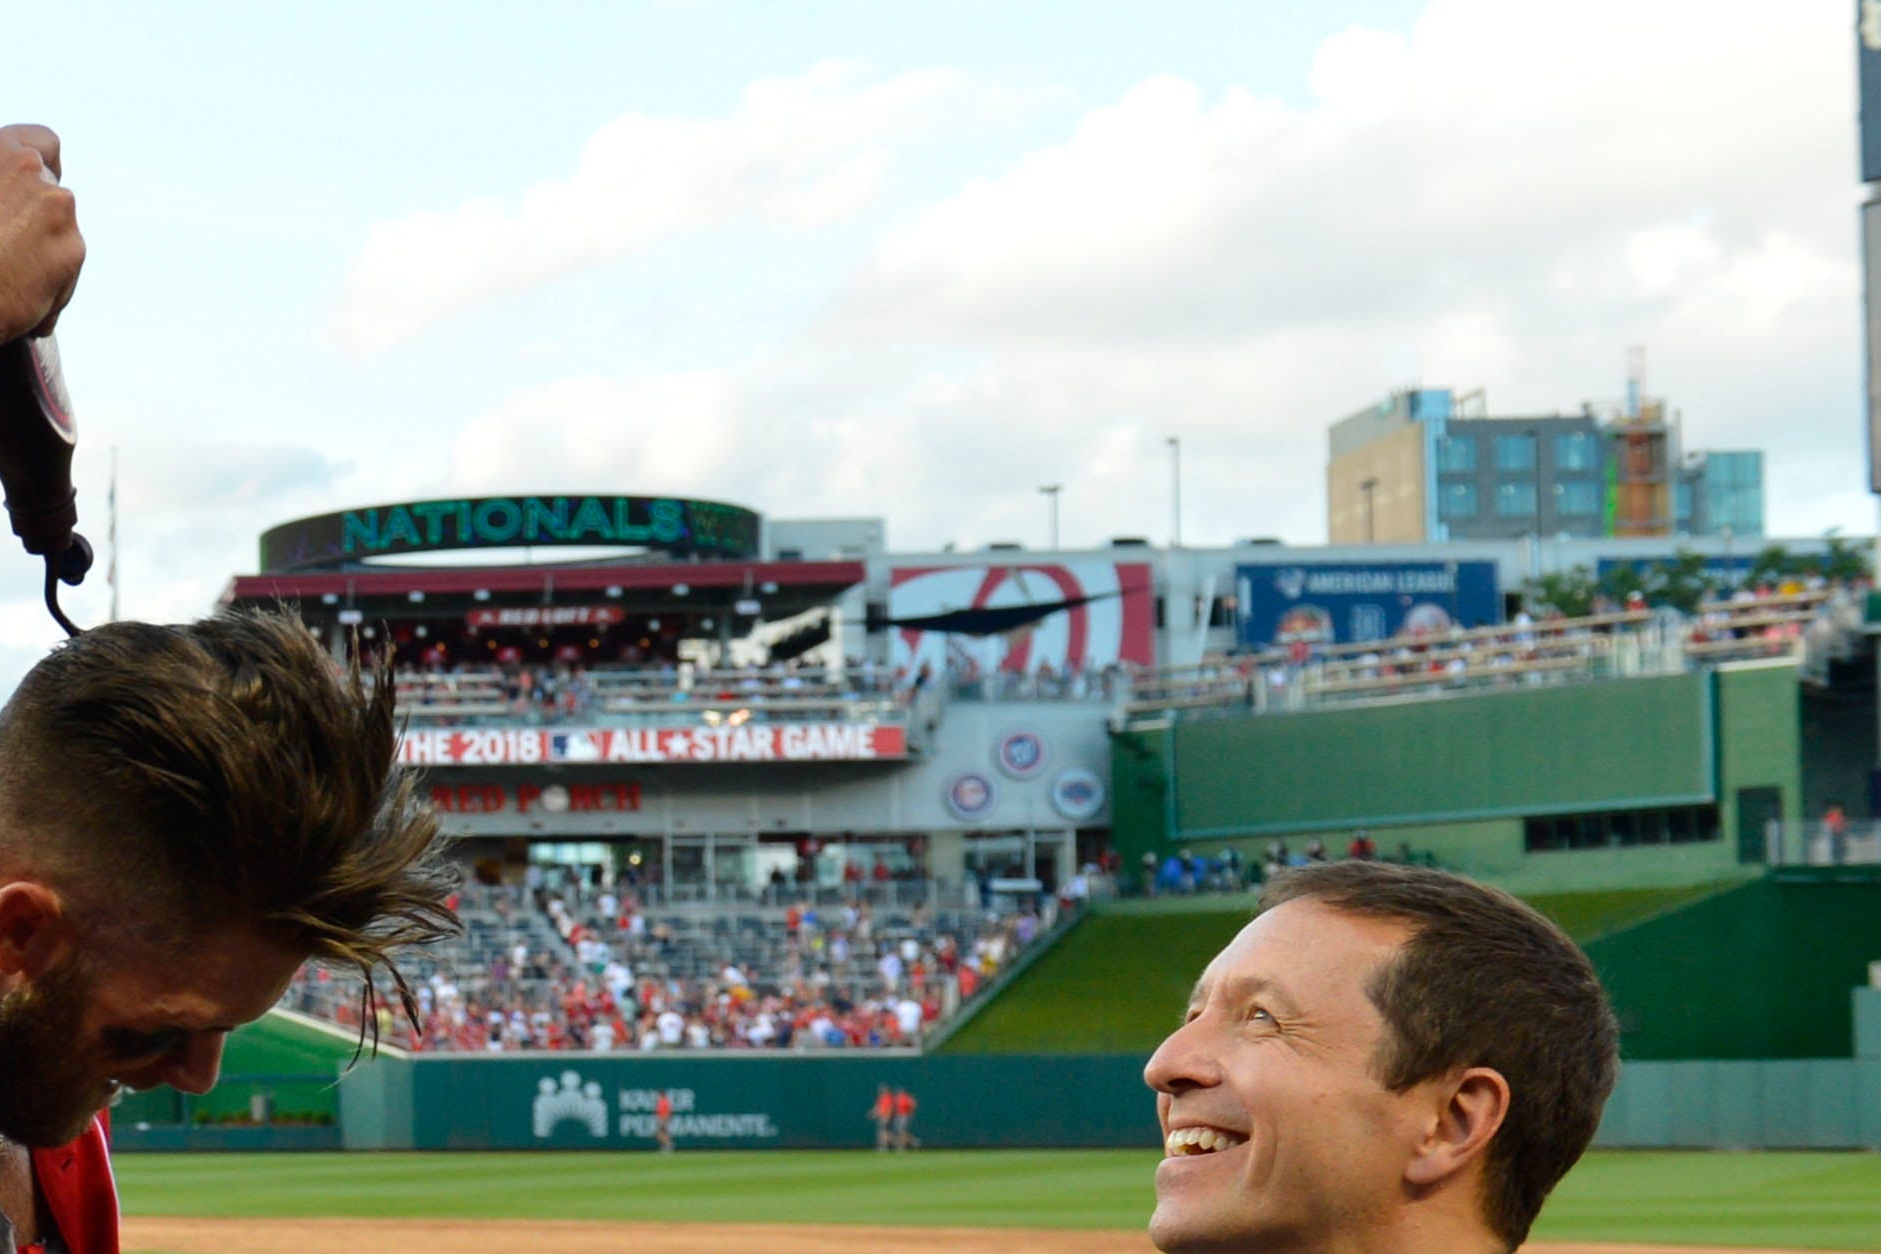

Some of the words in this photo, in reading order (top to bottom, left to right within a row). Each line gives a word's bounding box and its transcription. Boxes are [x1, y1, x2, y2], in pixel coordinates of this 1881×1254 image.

[342, 496, 684, 552] NATIONALS
[1309, 571, 1393, 594] AMERICAN
[397, 730, 451, 762] THE
[461, 730, 543, 762] 2018
[607, 728, 665, 760] ALL
[693, 726, 775, 759] STAR
[779, 725, 875, 758] GAME
[430, 784, 506, 813] RED
[620, 1088, 695, 1112] KAIER
